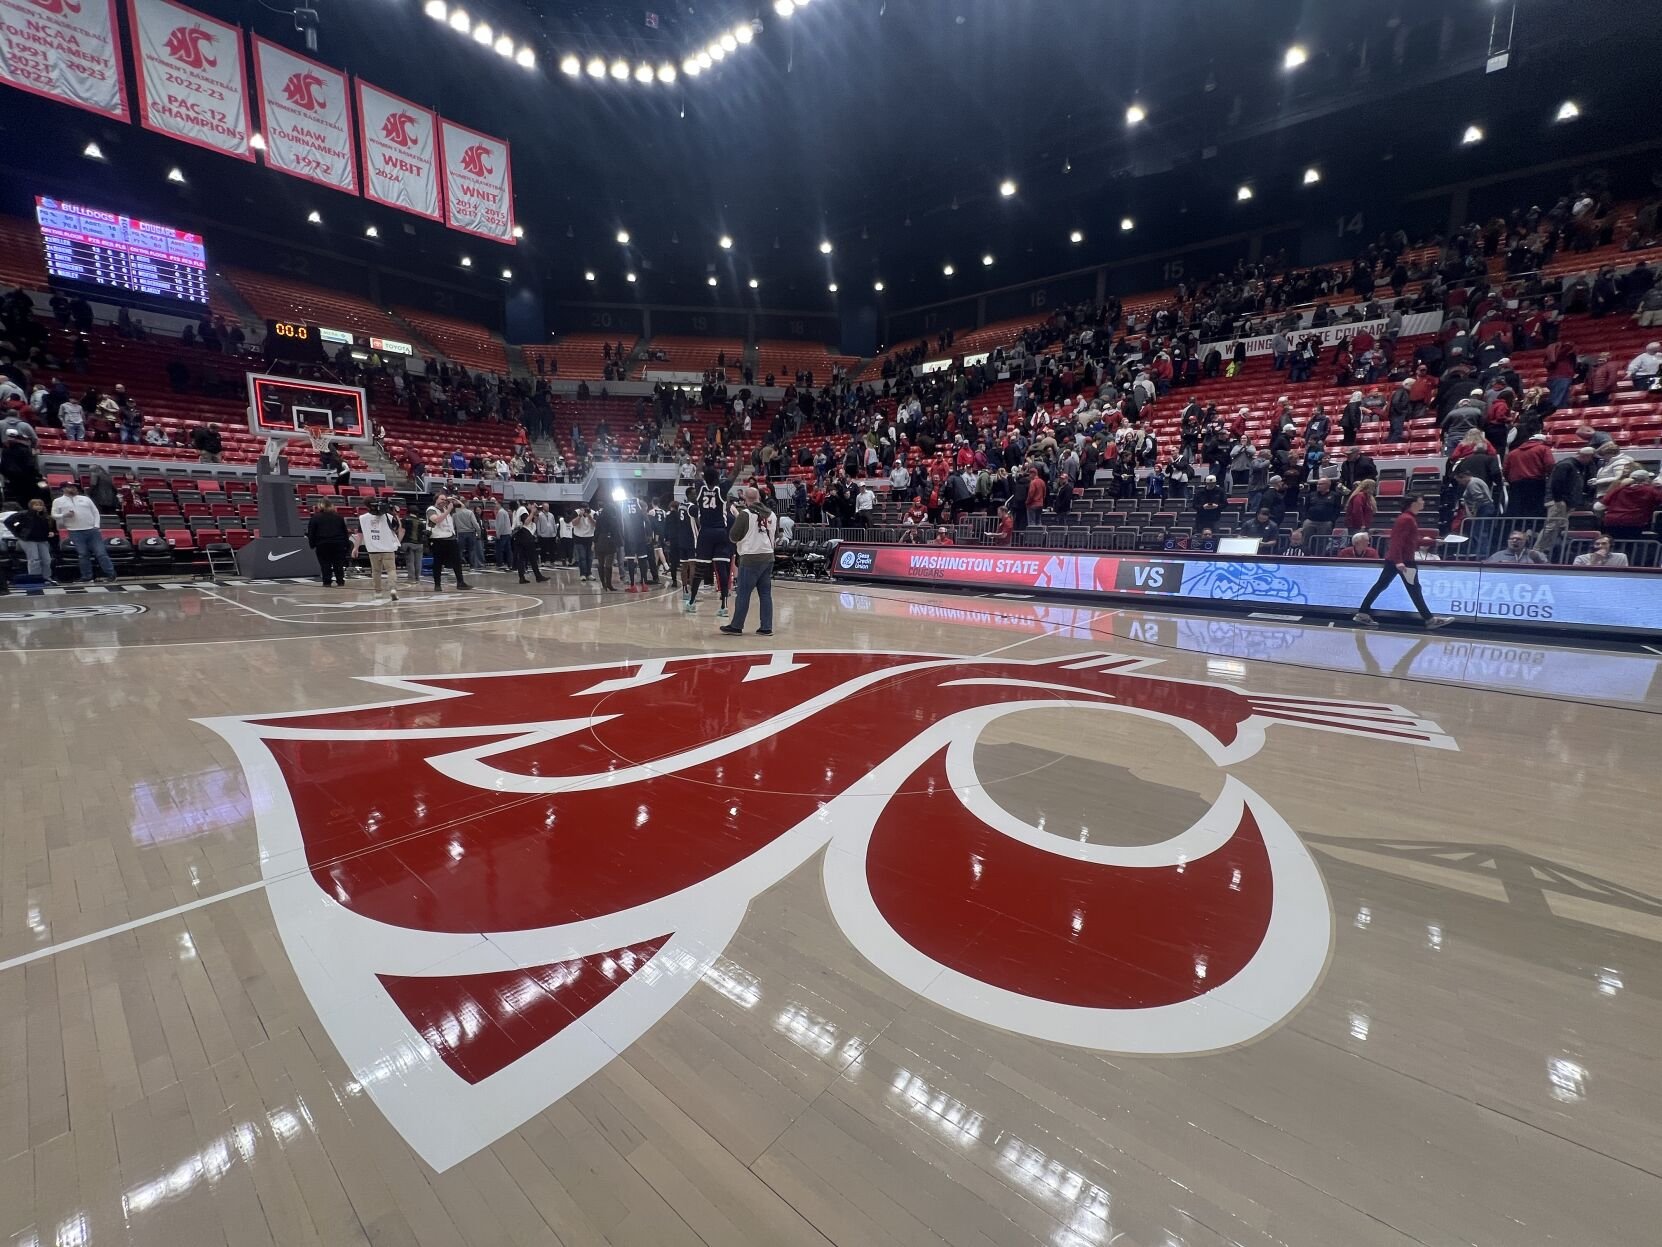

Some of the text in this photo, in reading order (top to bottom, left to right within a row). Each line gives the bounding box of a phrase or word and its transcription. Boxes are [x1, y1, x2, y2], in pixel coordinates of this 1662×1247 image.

[26, 20, 80, 47] NCAA
[9, 64, 56, 88] 2022
[65, 60, 106, 80] 2023
[165, 72, 224, 101] 2022-23
[190, 70, 238, 93] BASKETBALL
[167, 94, 227, 124] PAC-12
[150, 102, 244, 140] CHAMPIONS
[304, 112, 344, 132] BASKETBALL
[271, 127, 346, 160] TOURNAMENT
[292, 124, 326, 143] AIAW
[294, 154, 332, 176] 1972
[382, 152, 422, 177] WBIT
[376, 168, 400, 182] 2024
[461, 184, 498, 204] WNIT
[62, 204, 114, 221] BULLDOGS
[456, 198, 505, 218] 2014 2015
[140, 222, 176, 238] COUGARS
[1337, 211, 1364, 238] 14
[1162, 260, 1185, 280] 15
[1031, 288, 1048, 308] 16
[592, 312, 612, 328] 20
[276, 324, 307, 339] 00.0
[385, 342, 411, 353] TOYOTA
[1226, 336, 1294, 354] WHINGN
[628, 504, 637, 514] 15
[702, 496, 716, 509] 24
[680, 510, 684, 520] 5
[908, 567, 944, 578] COUGARS
[910, 556, 1038, 575] WASHINGTON STATE
[1134, 566, 1164, 588] VS
[1419, 578, 1556, 604] GONZAGA
[1450, 600, 1553, 618] BULLDOGS
